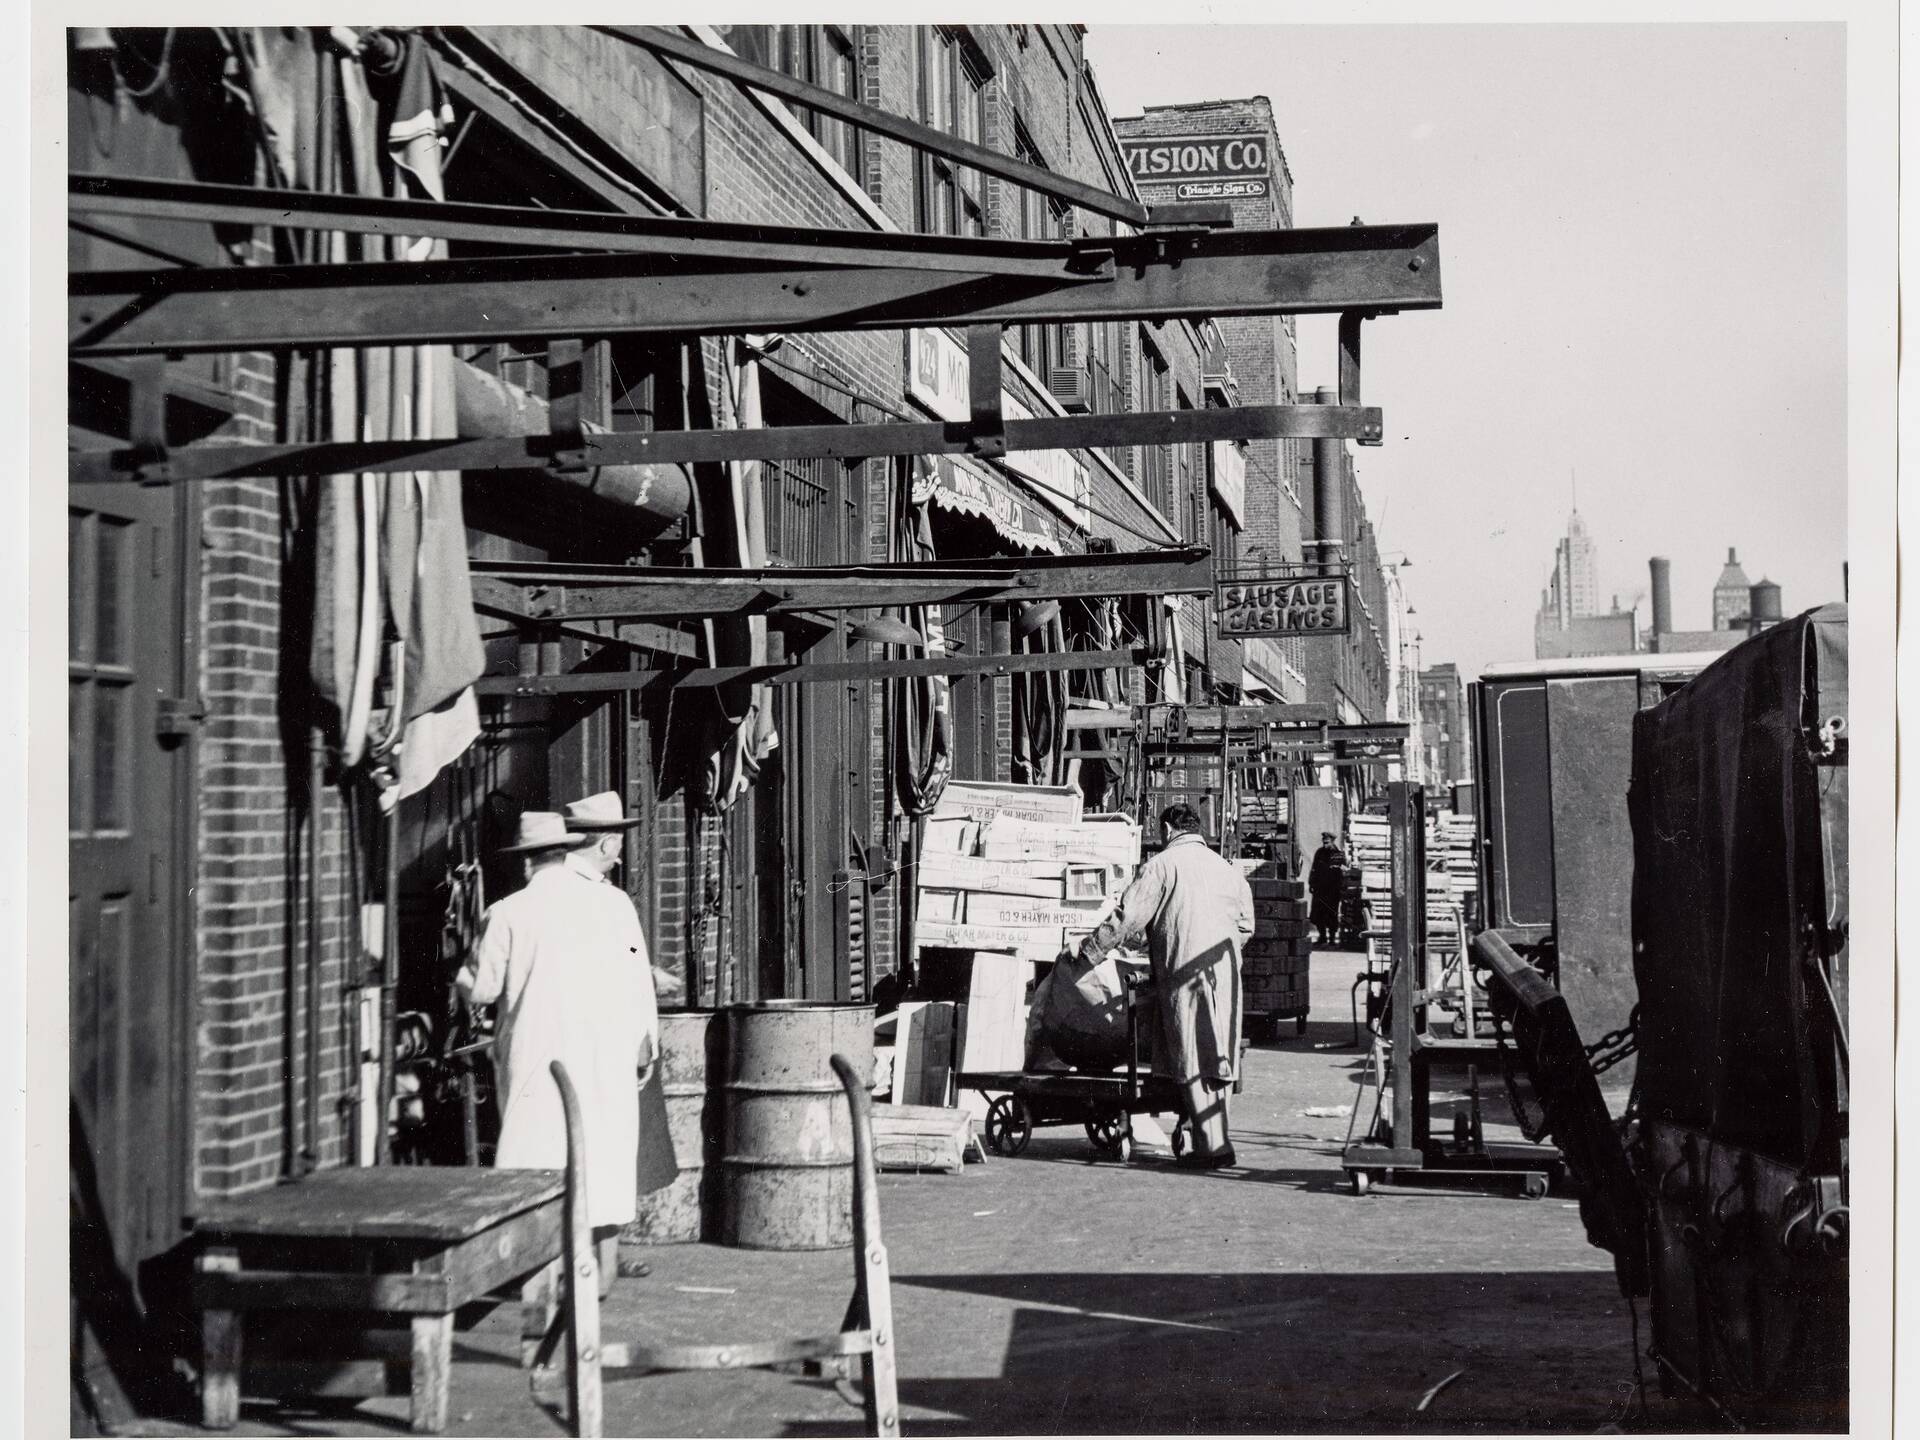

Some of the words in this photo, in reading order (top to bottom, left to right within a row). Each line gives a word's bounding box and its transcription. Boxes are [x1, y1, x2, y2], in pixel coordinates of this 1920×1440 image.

[1224, 140, 1267, 171] CO.
[1226, 583, 1337, 609] SAUSAGE
[1229, 606, 1336, 631] CASINGS
[1012, 911, 1020, 922] &
[1021, 911, 1051, 924] MAYER
